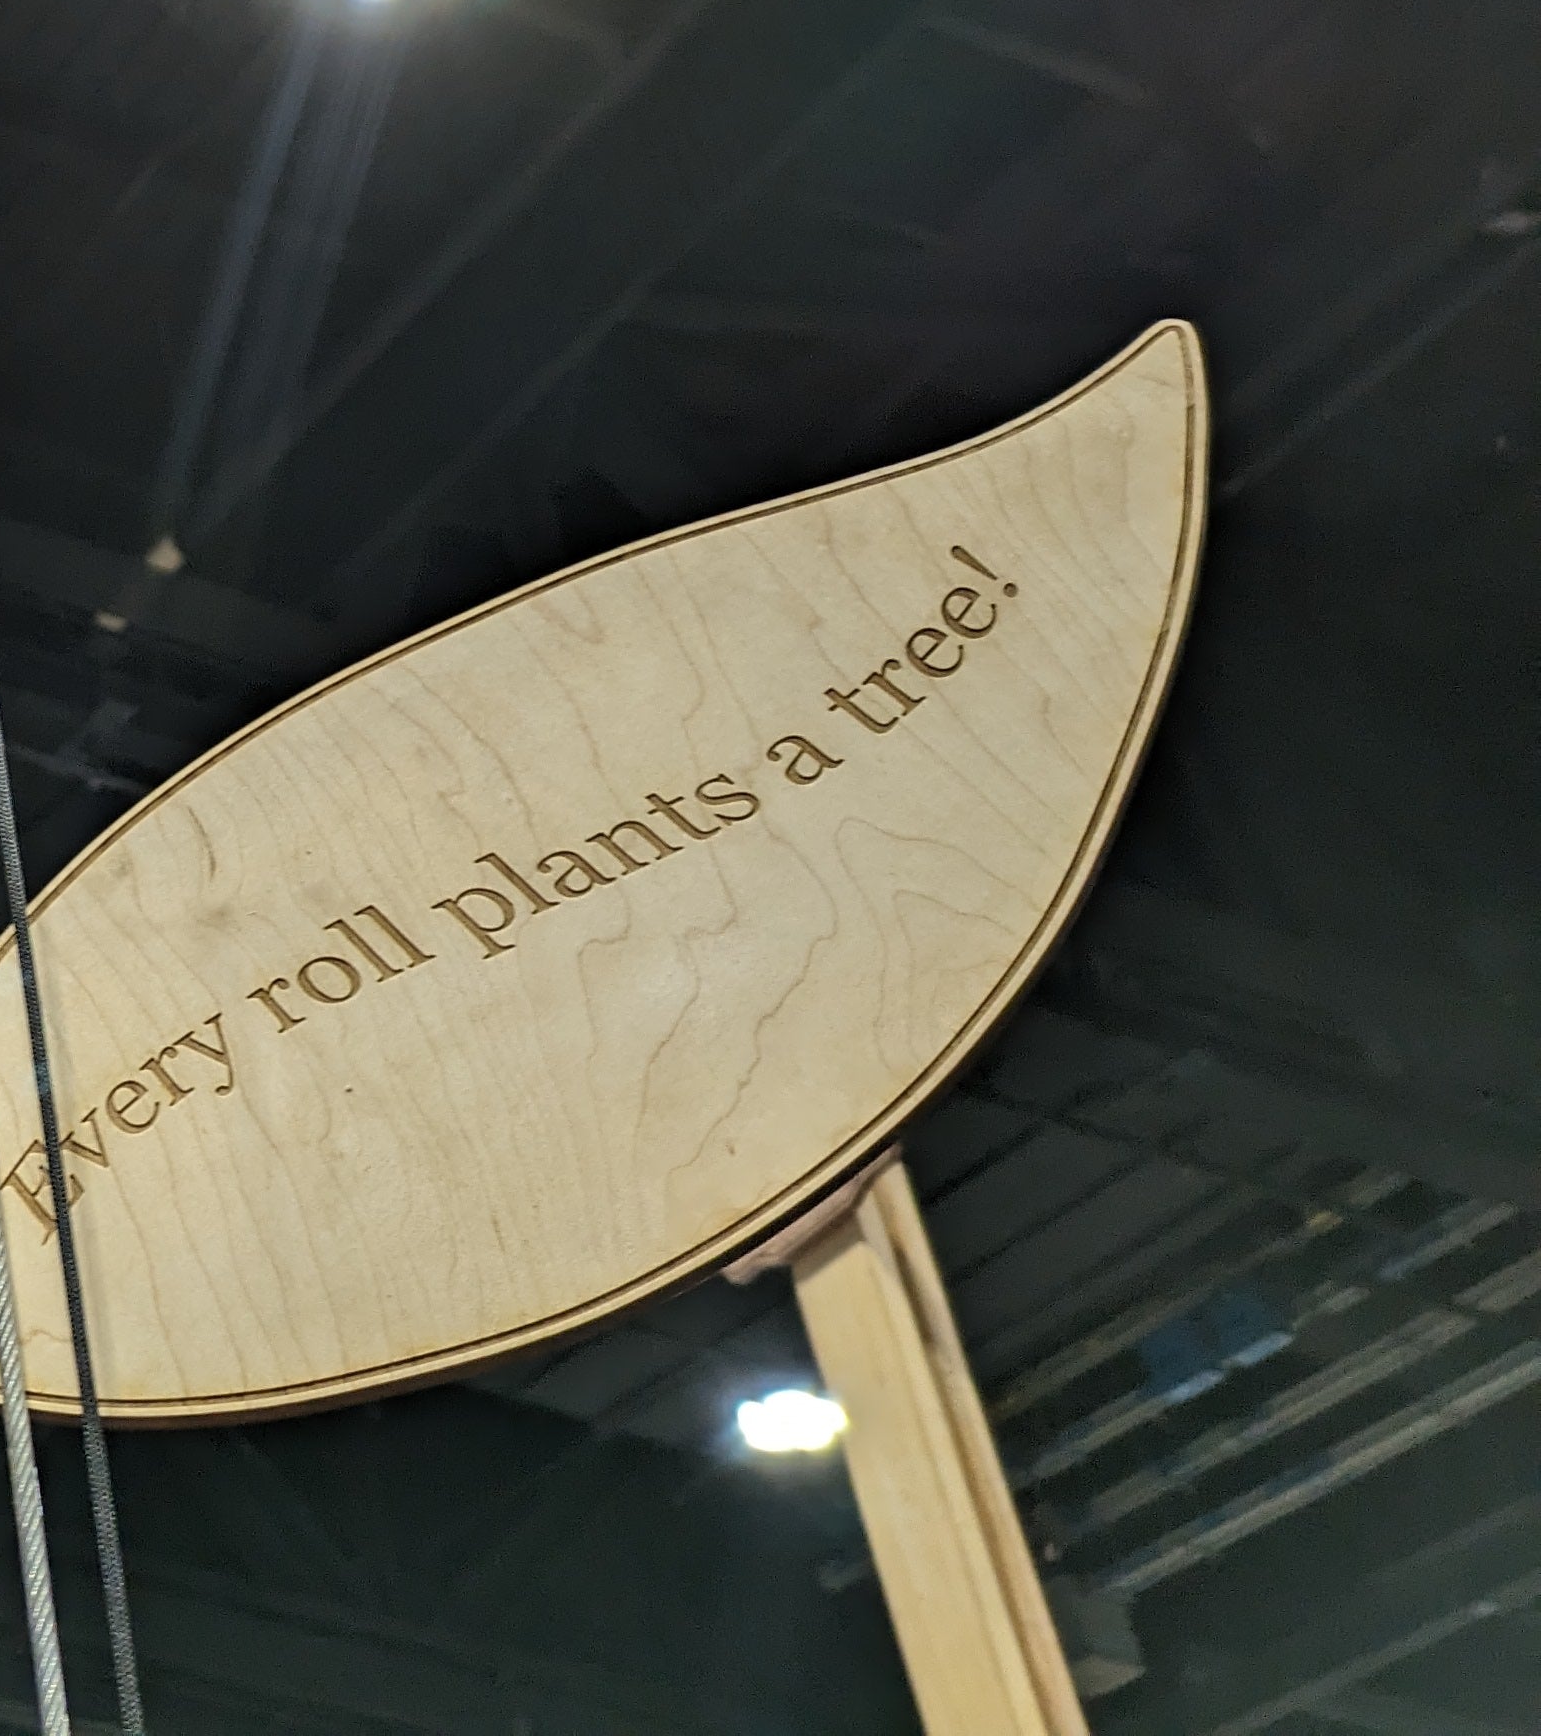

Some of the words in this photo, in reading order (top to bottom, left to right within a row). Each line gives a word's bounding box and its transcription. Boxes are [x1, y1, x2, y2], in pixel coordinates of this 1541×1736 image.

[245, 904, 437, 1034] roll
[430, 773, 761, 960] plants
[766, 734, 846, 786] a
[823, 544, 1019, 735] tree!
